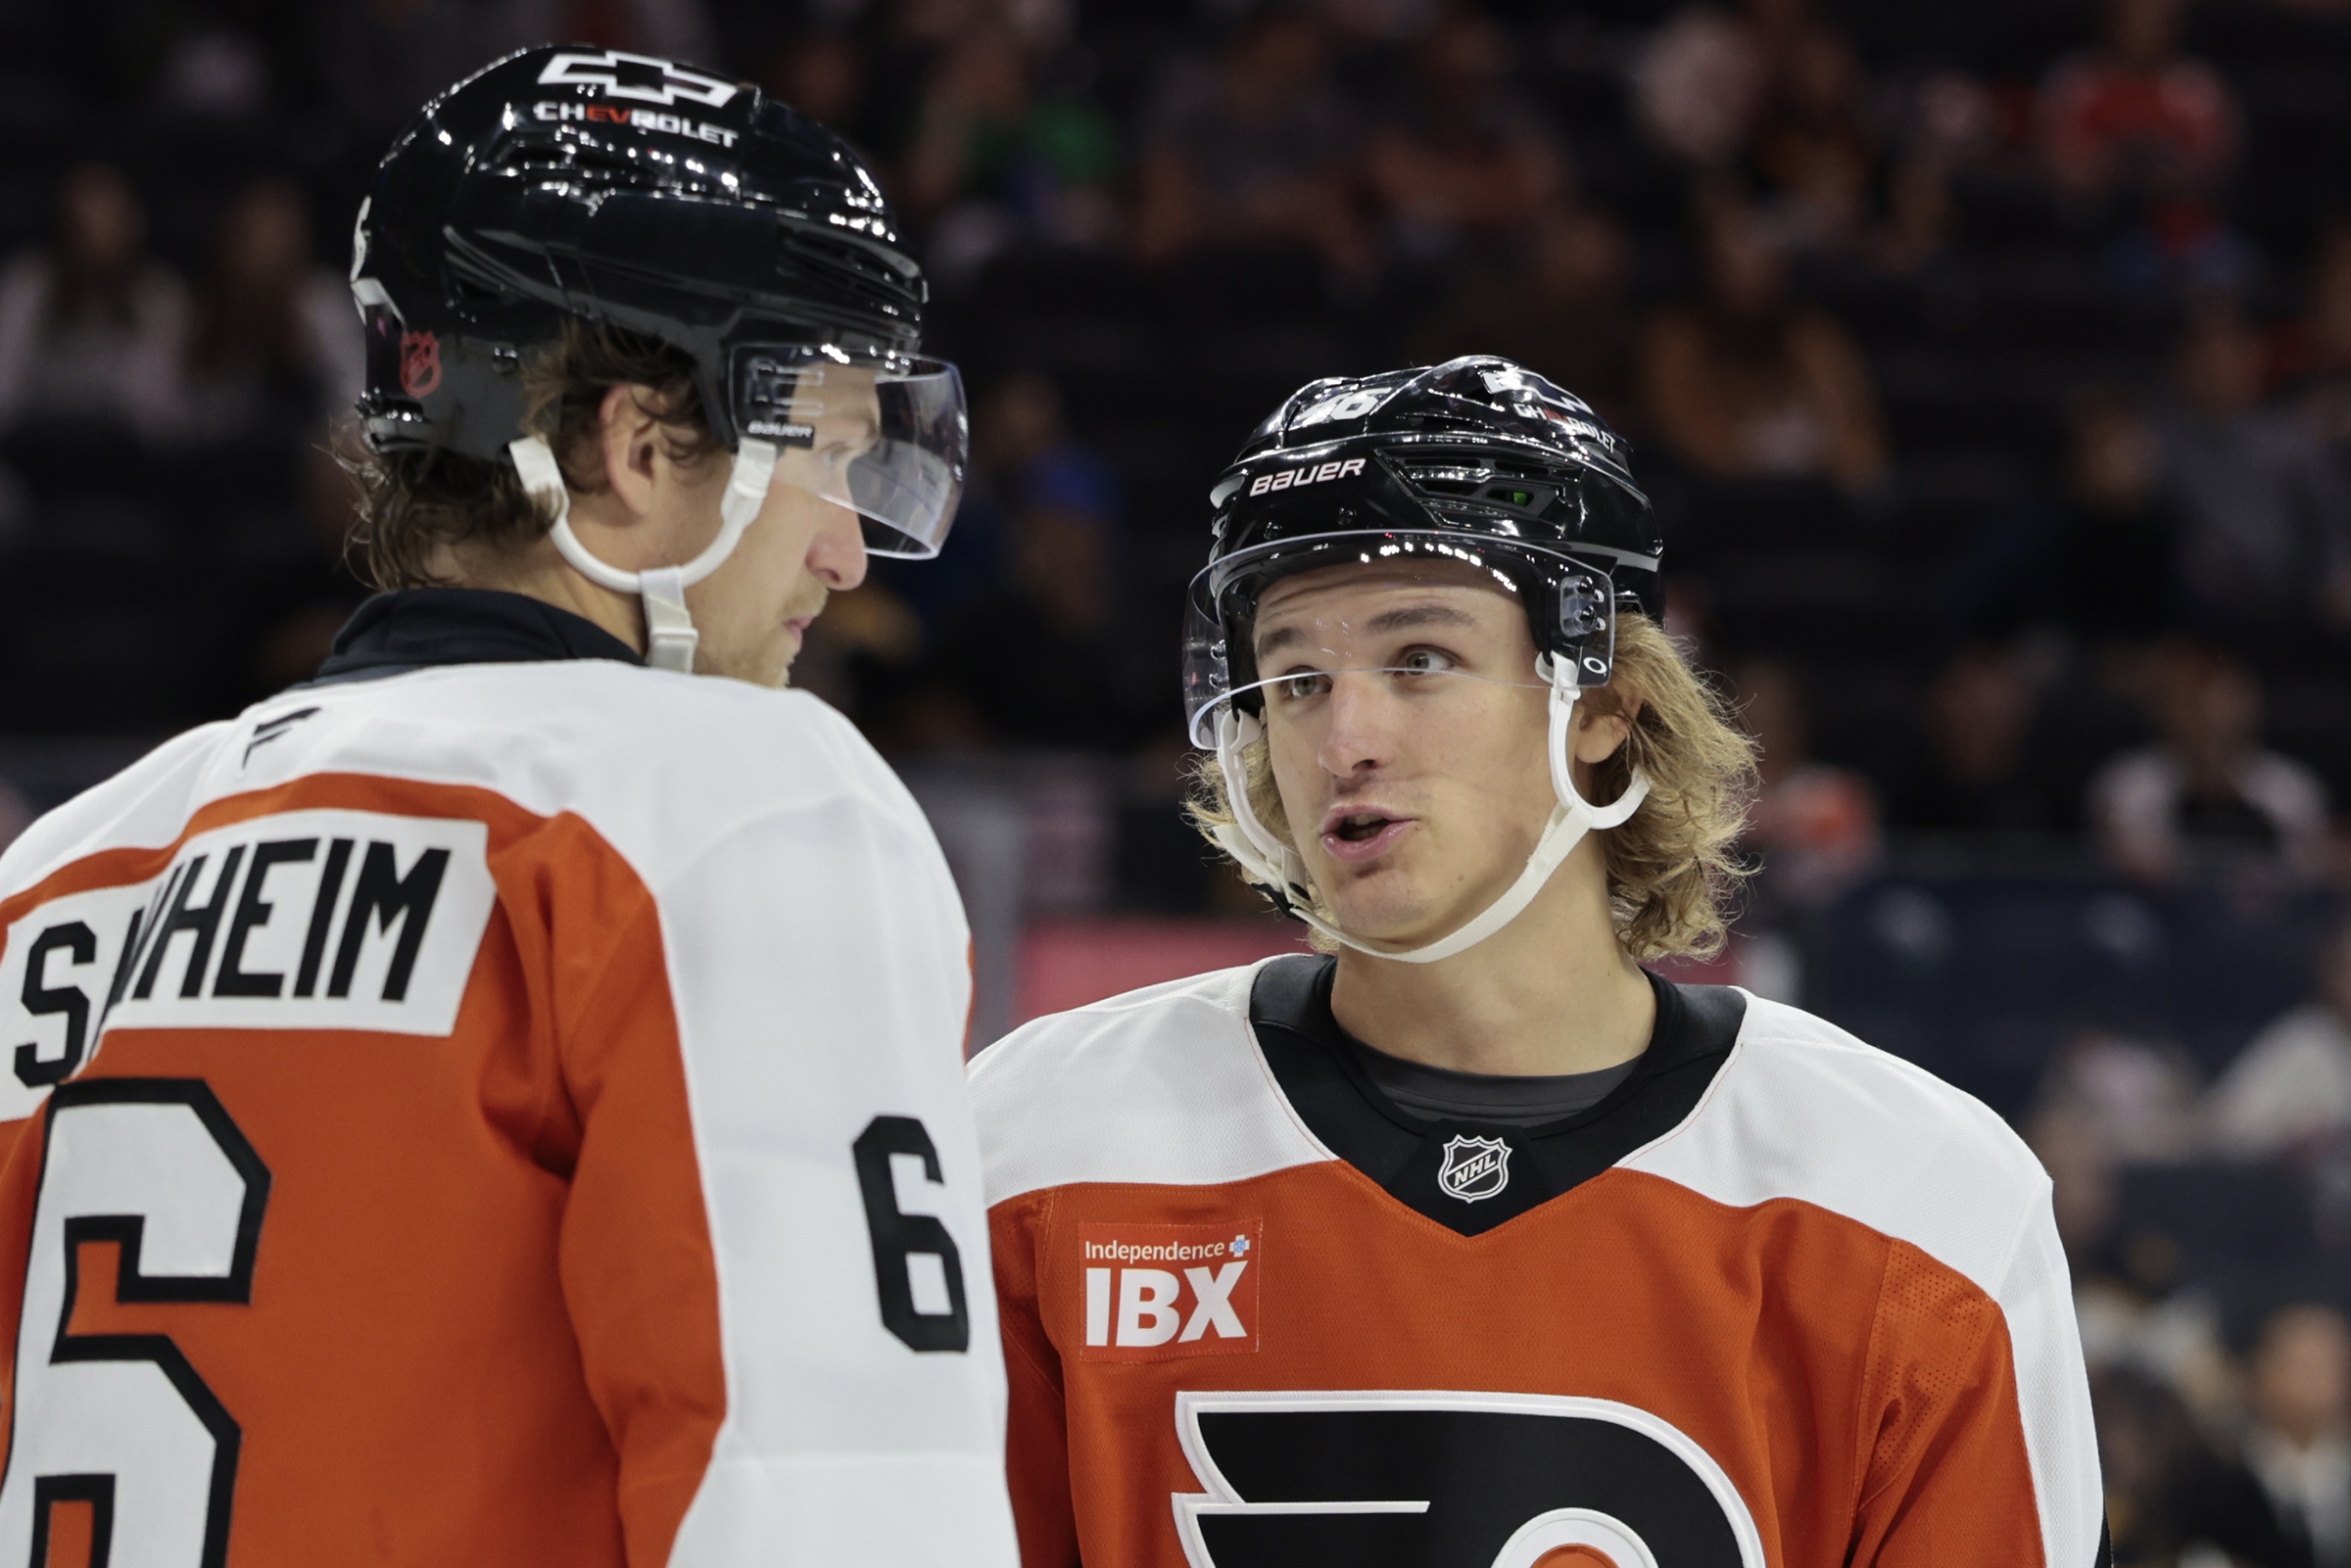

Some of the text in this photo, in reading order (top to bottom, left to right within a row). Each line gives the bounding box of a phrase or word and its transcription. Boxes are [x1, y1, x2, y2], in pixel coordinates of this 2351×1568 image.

[533, 101, 740, 148] CHEVROLET
[1249, 458, 1367, 498] BAUER
[14, 837, 453, 1088] SHEIM
[1454, 1154, 1497, 1187] NHL
[851, 1115, 970, 1354] 6
[1084, 1239, 1225, 1264] Independence
[0, 1076, 274, 1568] 6
[1085, 1259, 1249, 1348] IBX
